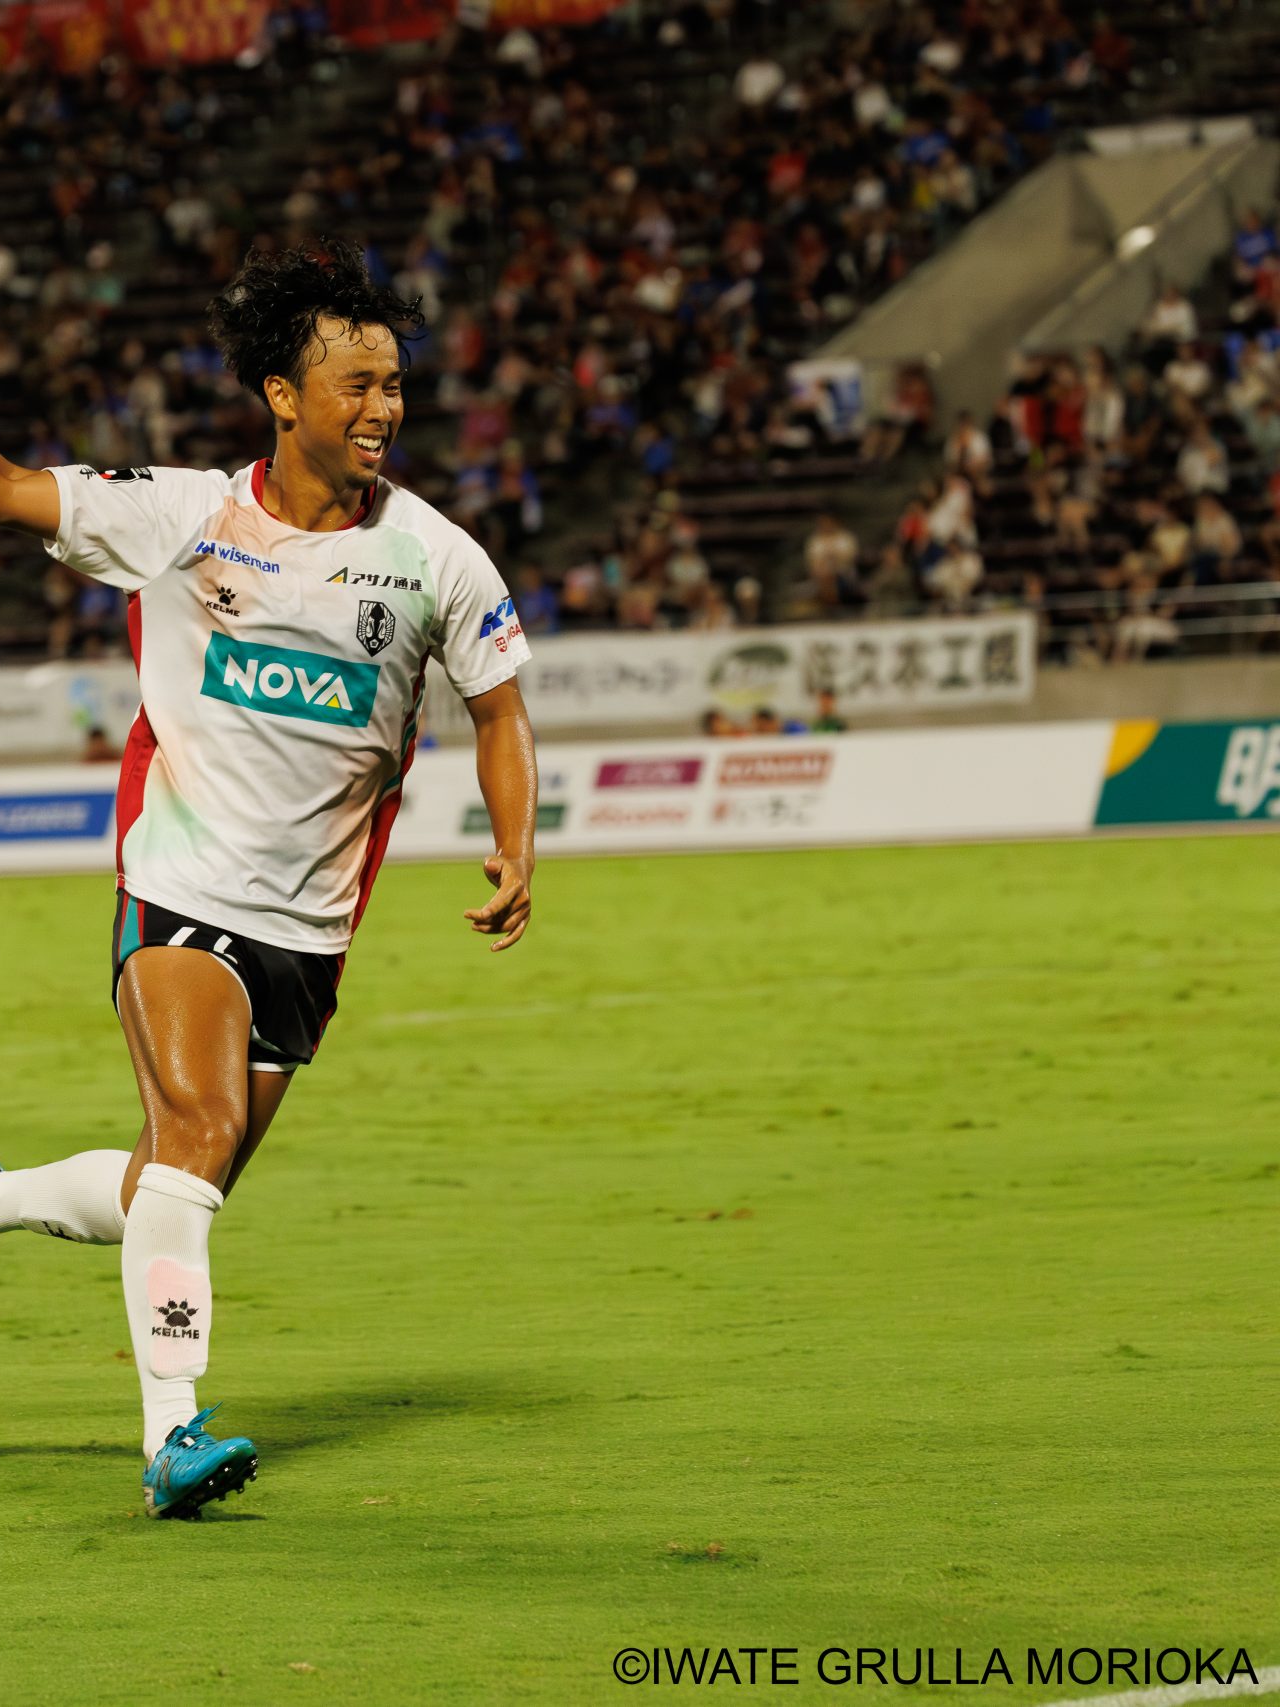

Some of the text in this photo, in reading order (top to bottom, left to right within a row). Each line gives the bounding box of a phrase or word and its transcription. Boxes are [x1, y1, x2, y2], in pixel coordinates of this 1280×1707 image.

[218, 546, 280, 574] wiseman
[205, 600, 240, 618] KELME
[223, 653, 353, 712] NOVA
[152, 1326, 200, 1340] KELME
